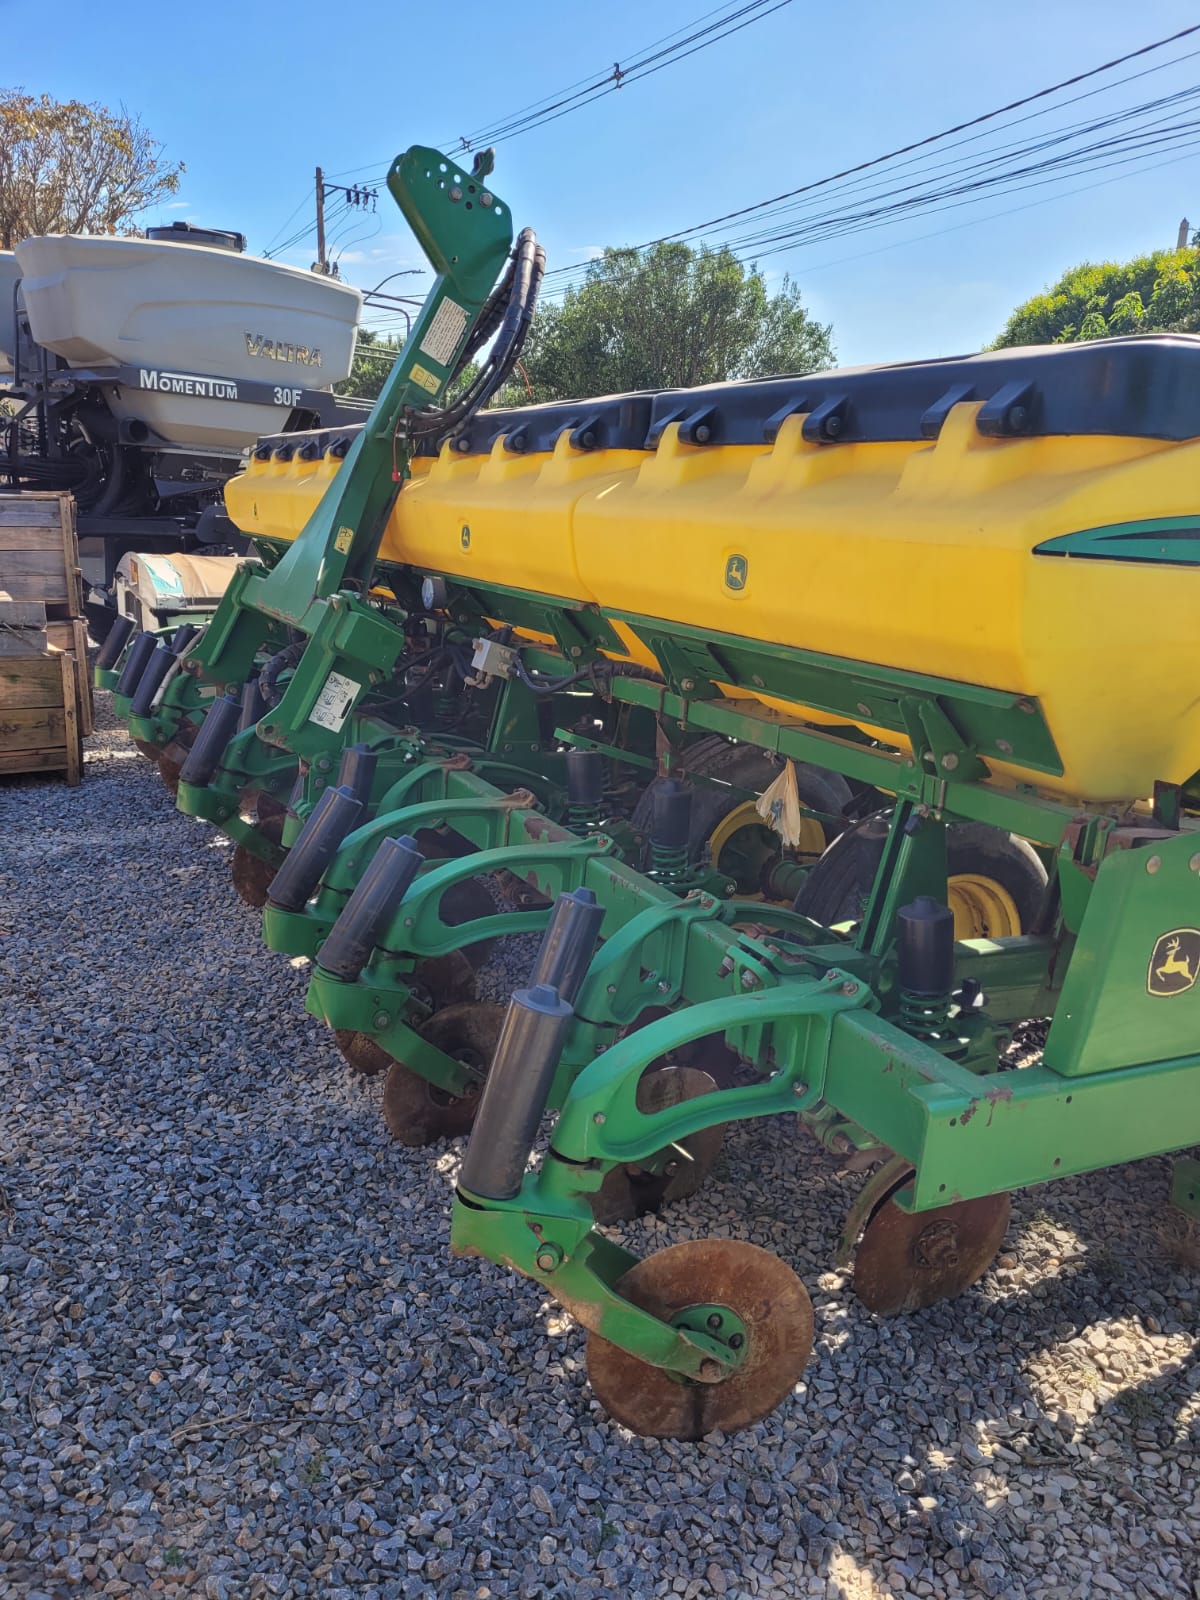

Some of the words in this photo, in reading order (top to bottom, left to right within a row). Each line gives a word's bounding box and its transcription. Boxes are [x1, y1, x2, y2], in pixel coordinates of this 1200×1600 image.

[244, 330, 323, 368] VALTRA
[139, 369, 238, 400] MOMENTUM
[273, 386, 302, 407] 30F
